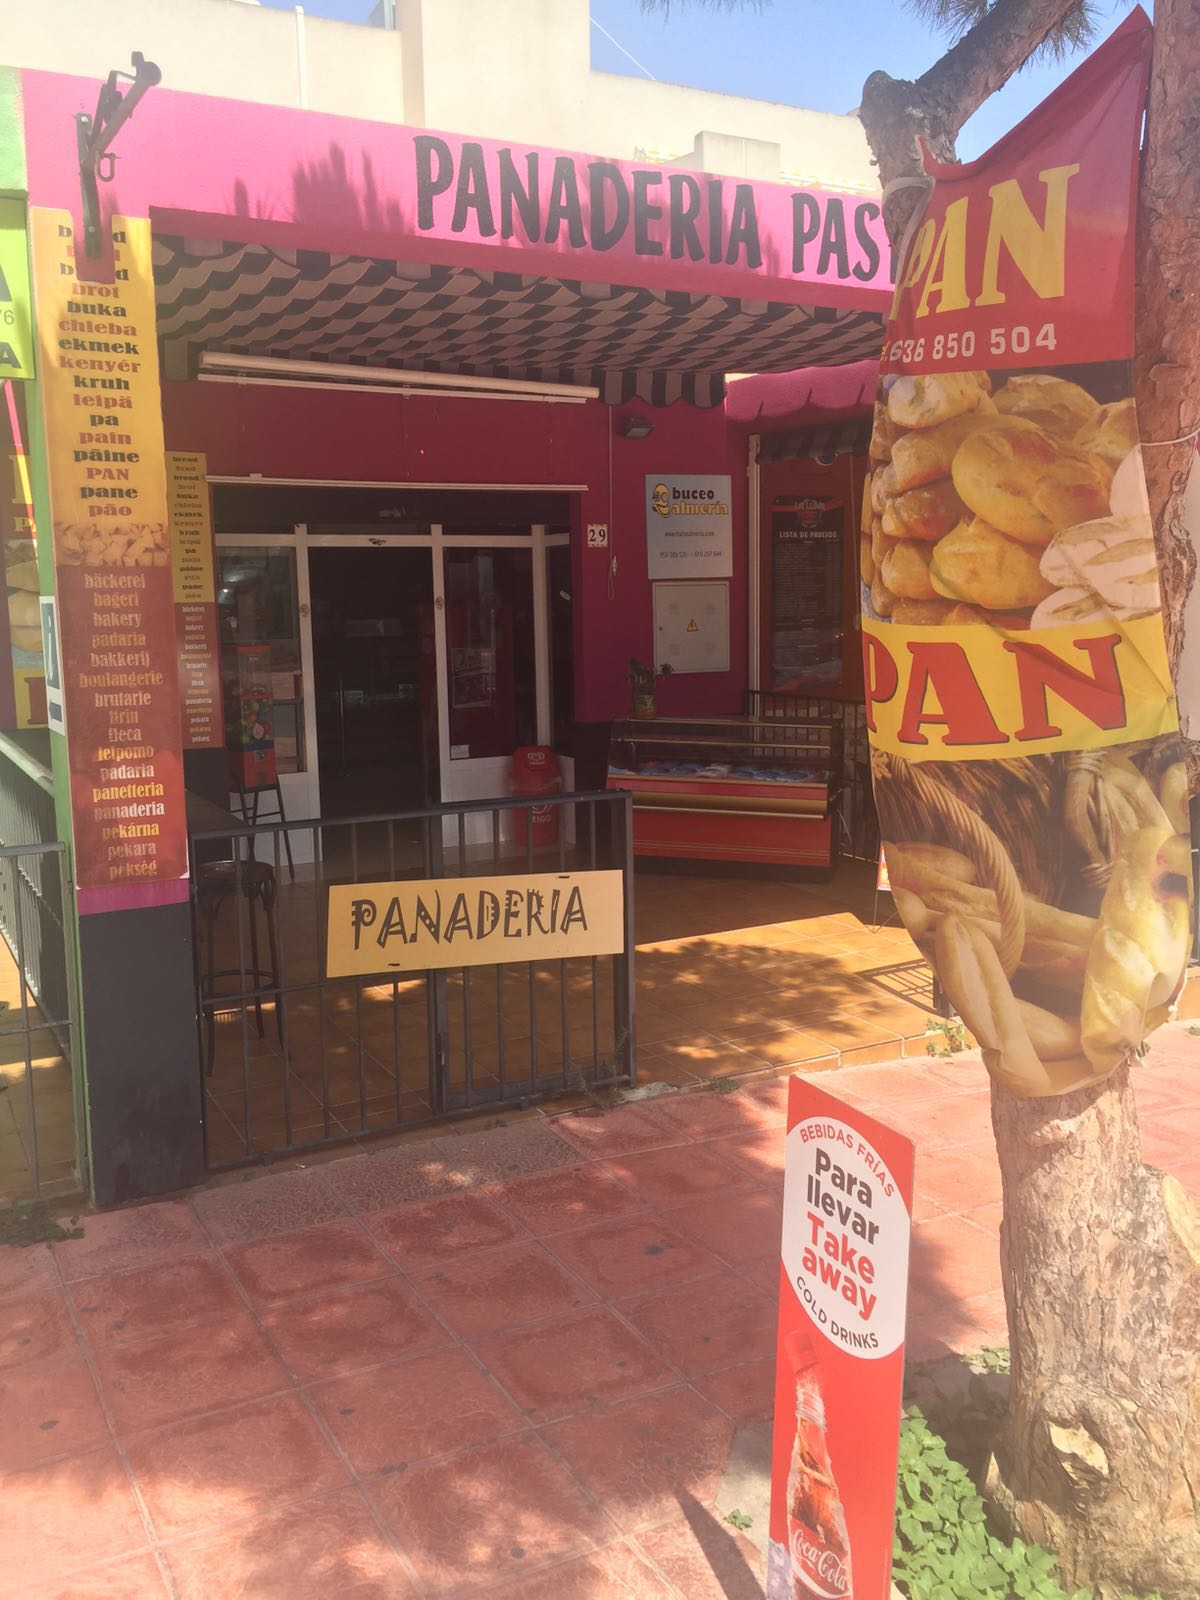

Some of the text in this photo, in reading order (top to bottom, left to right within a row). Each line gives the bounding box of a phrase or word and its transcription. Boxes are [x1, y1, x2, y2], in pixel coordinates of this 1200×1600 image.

[413, 135, 896, 284] PANADERIA PAS
[889, 163, 1080, 319] PAN
[67, 301, 126, 317] buka
[58, 320, 137, 336] chleba
[58, 338, 140, 355] ekmek
[889, 323, 1057, 364] 636 850 504
[59, 356, 141, 373] kenyér
[73, 375, 130, 390] kruh
[73, 394, 133, 409] leipä
[90, 414, 118, 426] pa
[80, 432, 131, 445] pain
[86, 467, 129, 480] PAN
[80, 486, 138, 499] pane
[672, 487, 715, 500] buceo
[88, 503, 132, 517] pão
[671, 500, 729, 515] almería
[589, 528, 606, 543] 29
[84, 573, 146, 589] bäckerei
[93, 592, 139, 609] bageri
[93, 612, 142, 628] bakery
[90, 650, 150, 668] bakkerij
[79, 670, 164, 688] boulangerie
[862, 632, 1127, 745] PAN
[95, 691, 152, 708] brutarie
[98, 745, 154, 762] leipomo
[100, 764, 155, 782] padaria
[92, 782, 165, 802] panetteria
[351, 885, 588, 950] PANADERIA
[800, 1123, 895, 1198] BEBIDAS FRÍAS
[815, 1147, 873, 1209] Para
[807, 1174, 880, 1246] llevar
[807, 1210, 875, 1285] Take
[802, 1246, 877, 1321] away
[796, 1276, 879, 1350] COLD DRINKS
